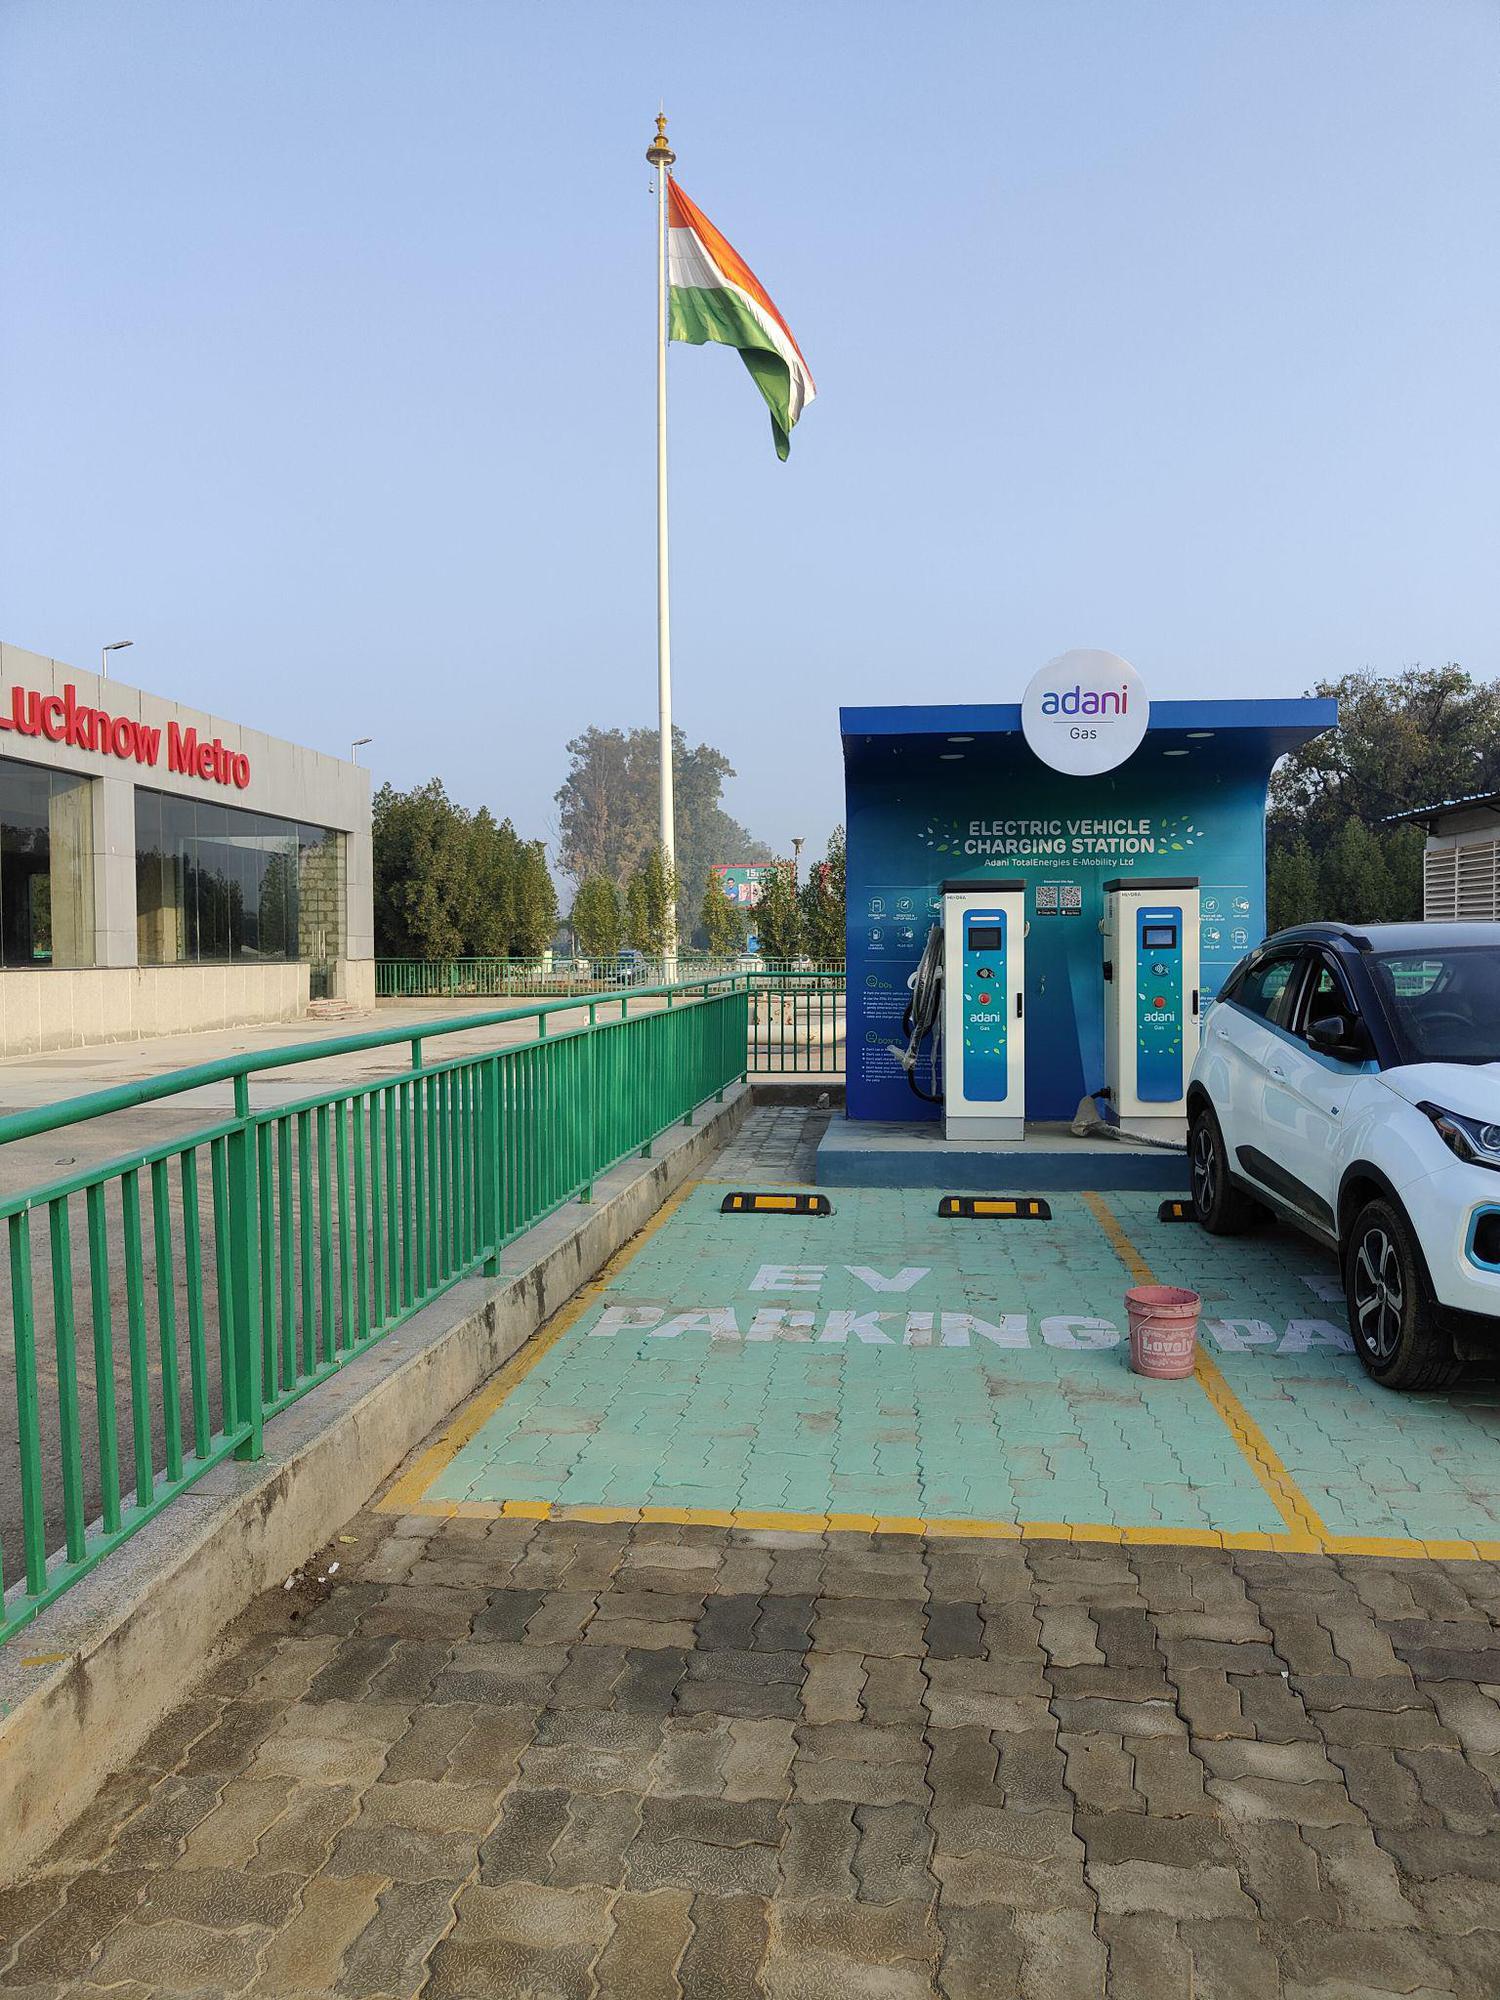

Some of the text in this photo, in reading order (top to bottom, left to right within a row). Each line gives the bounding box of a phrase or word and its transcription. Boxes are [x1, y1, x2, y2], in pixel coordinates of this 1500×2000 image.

[1041, 685, 1128, 715] adani
[0, 684, 251, 789] ucknow Metro
[1069, 727, 1097, 740] Gas
[969, 819, 1151, 836] ELECTRIC VEHICLE
[964, 837, 1155, 854] CHARGING STATION
[984, 858, 1135, 868] Adani TotalEnergies E-Mobility Ltd
[970, 1012, 1001, 1023] adani
[1144, 1011, 1175, 1022] adani
[747, 1265, 933, 1292] EV
[587, 1306, 1121, 1350] PARKING
